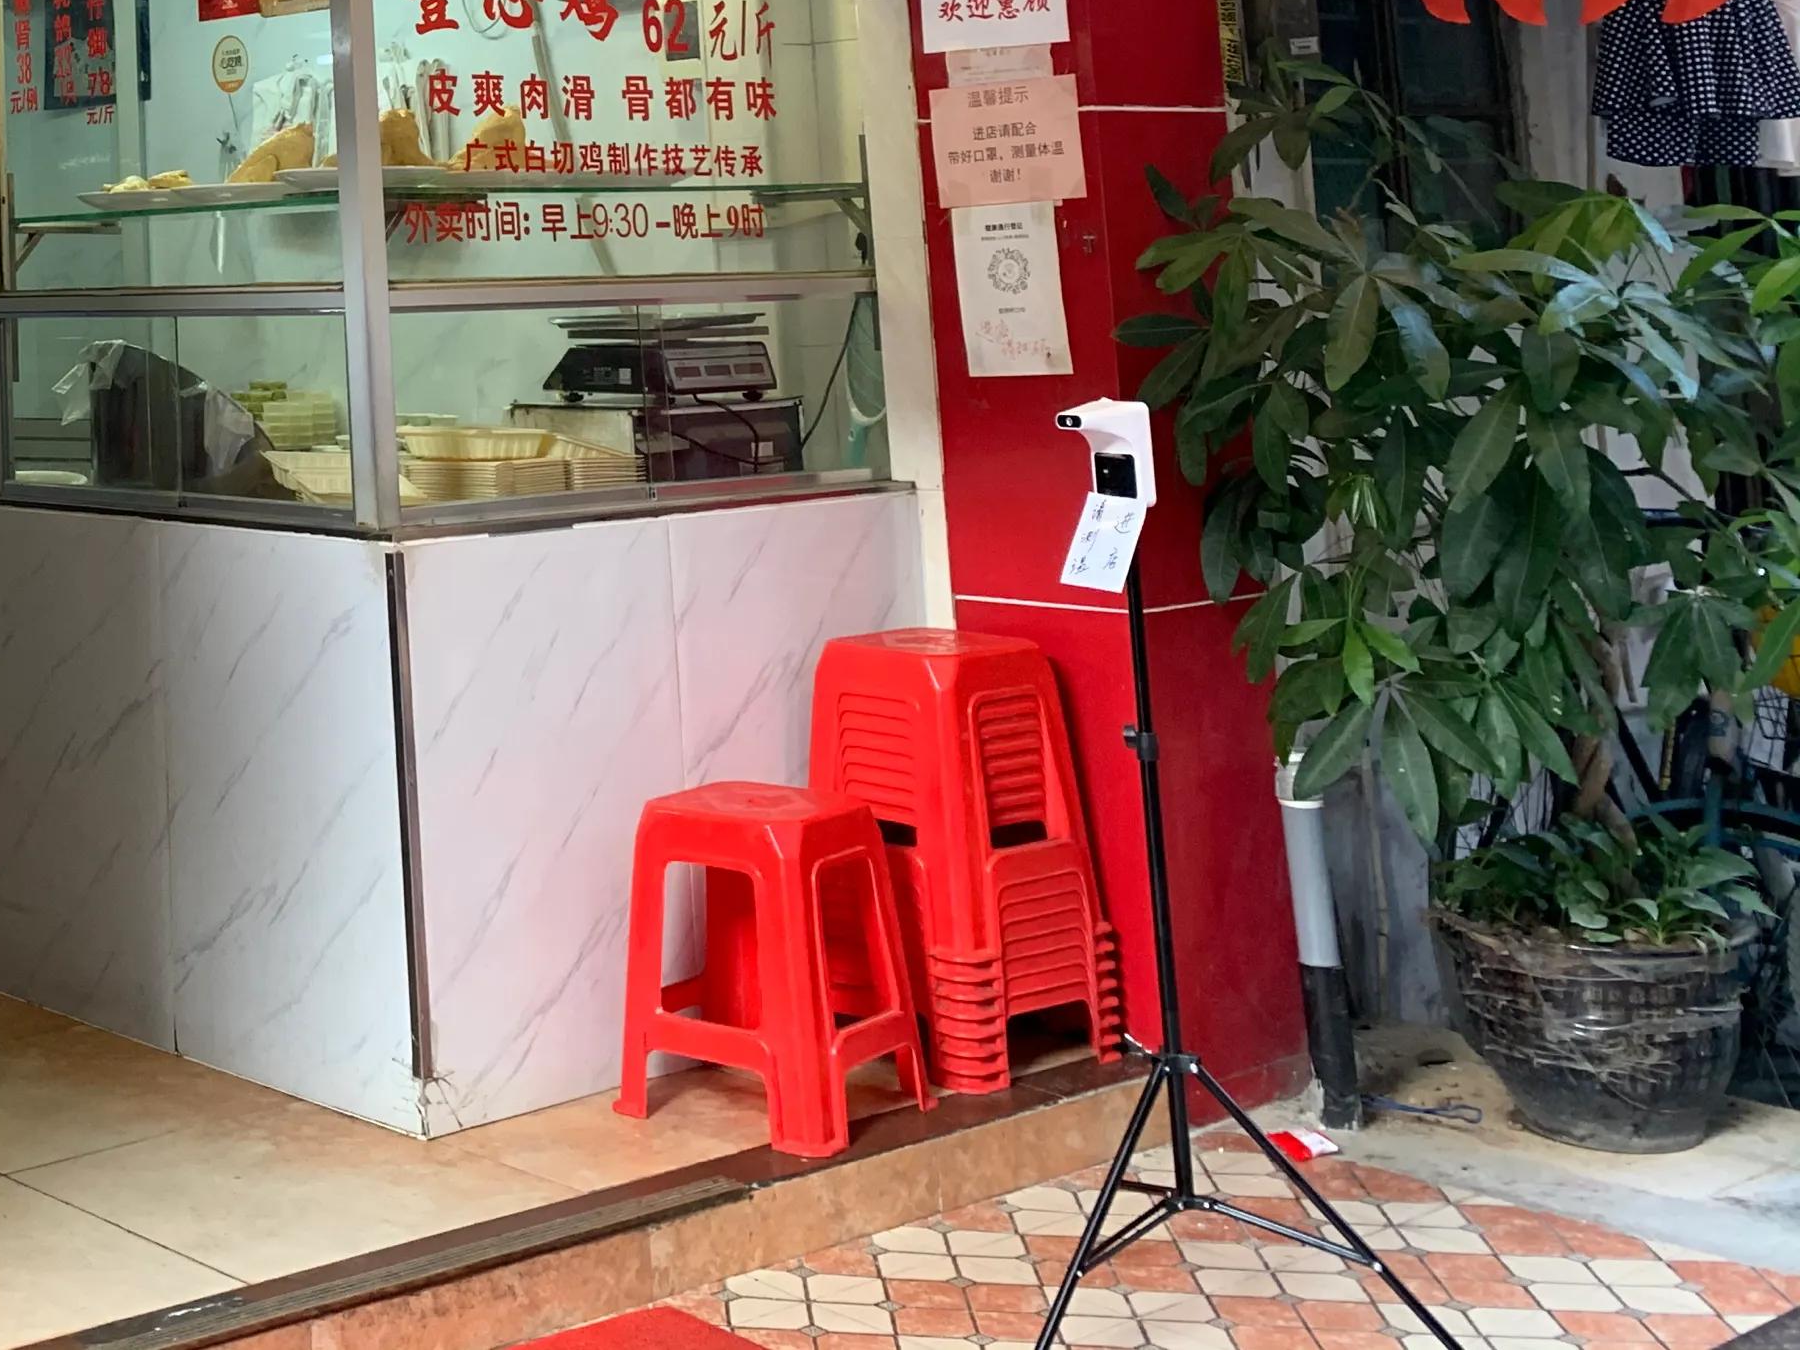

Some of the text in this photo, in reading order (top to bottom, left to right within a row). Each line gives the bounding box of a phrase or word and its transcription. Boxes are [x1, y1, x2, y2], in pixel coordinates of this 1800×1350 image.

[427, 68, 778, 123] 皮爽肉滑 骨都有味
[967, 84, 1030, 109] 温馨提示
[972, 120, 1038, 141] 进店请配合
[462, 140, 764, 179] 广式白切鸡制作技艺传承
[989, 167, 1022, 185] 谢谢！
